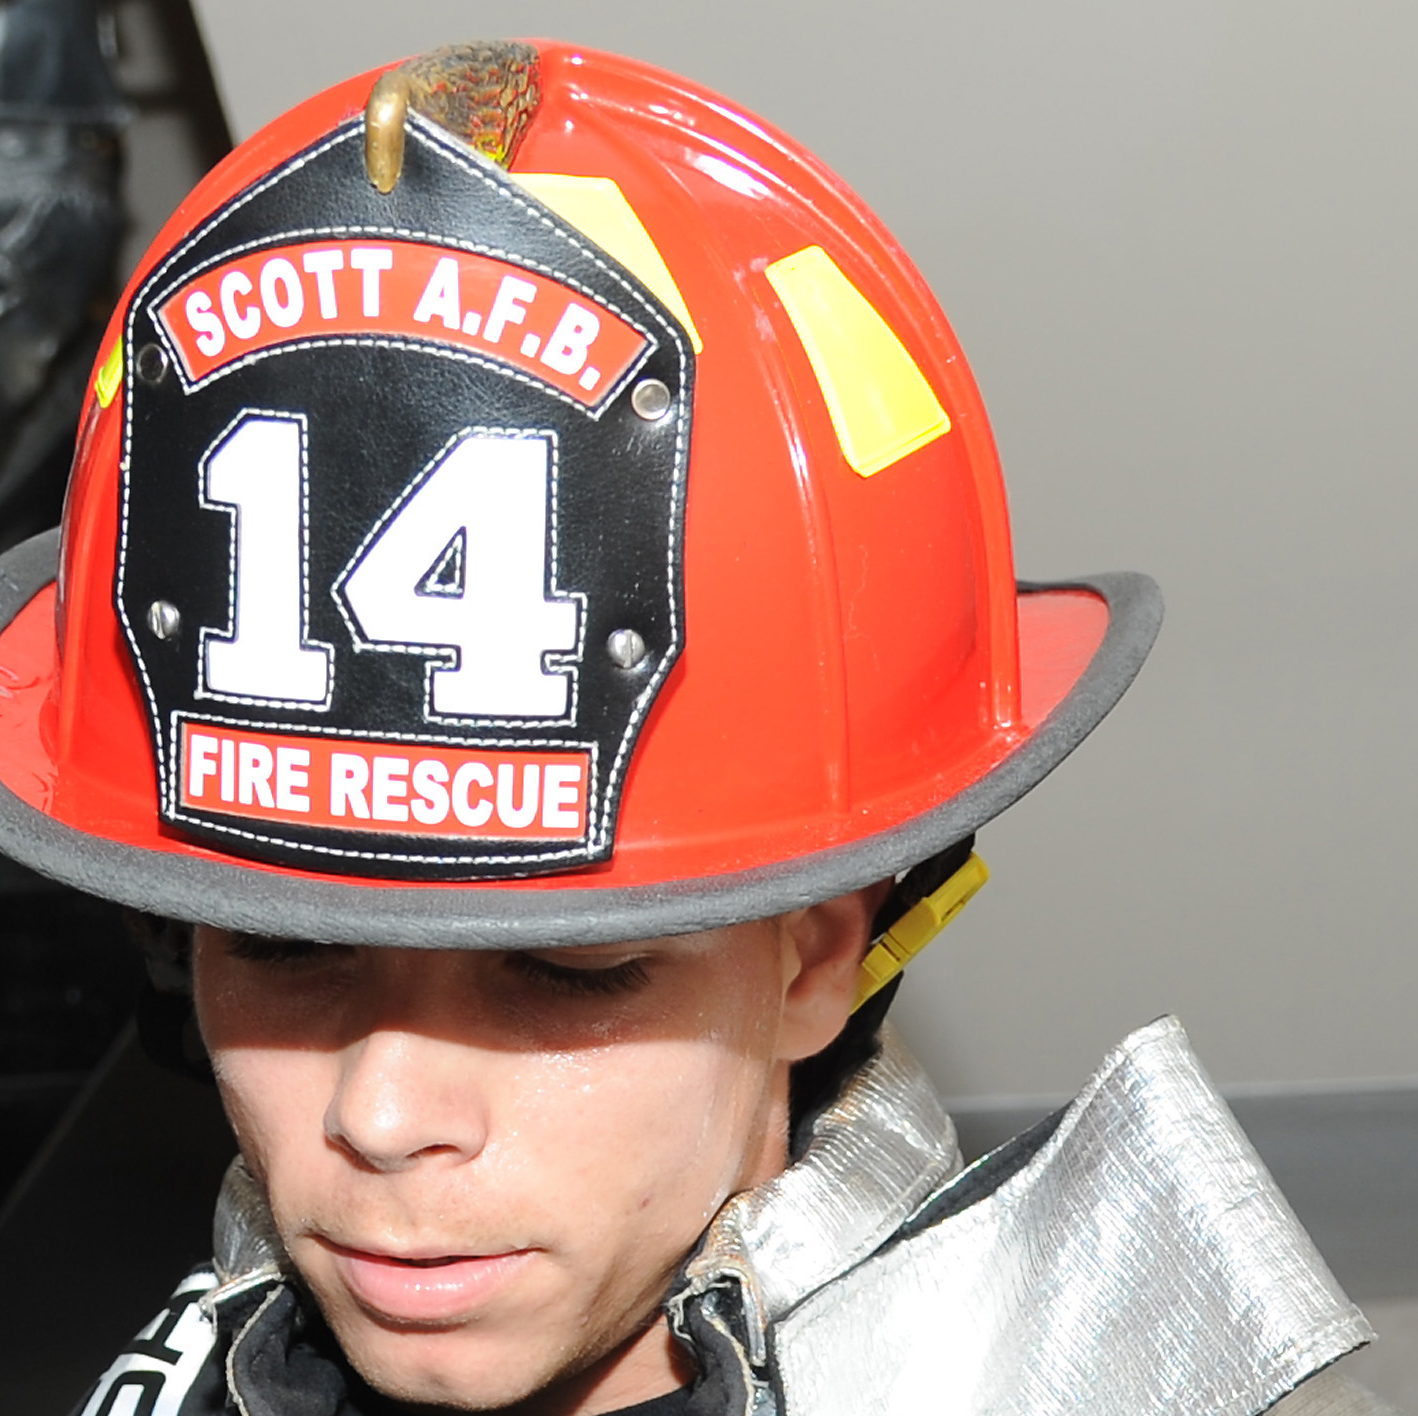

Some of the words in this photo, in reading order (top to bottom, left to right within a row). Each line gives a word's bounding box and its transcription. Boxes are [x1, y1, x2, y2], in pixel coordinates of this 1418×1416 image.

[185, 247, 393, 357] SCOTT
[413, 256, 602, 391] A.F.B.
[204, 417, 579, 717] 14
[188, 734, 310, 813] FIRE
[330, 751, 582, 829] RESCUE
